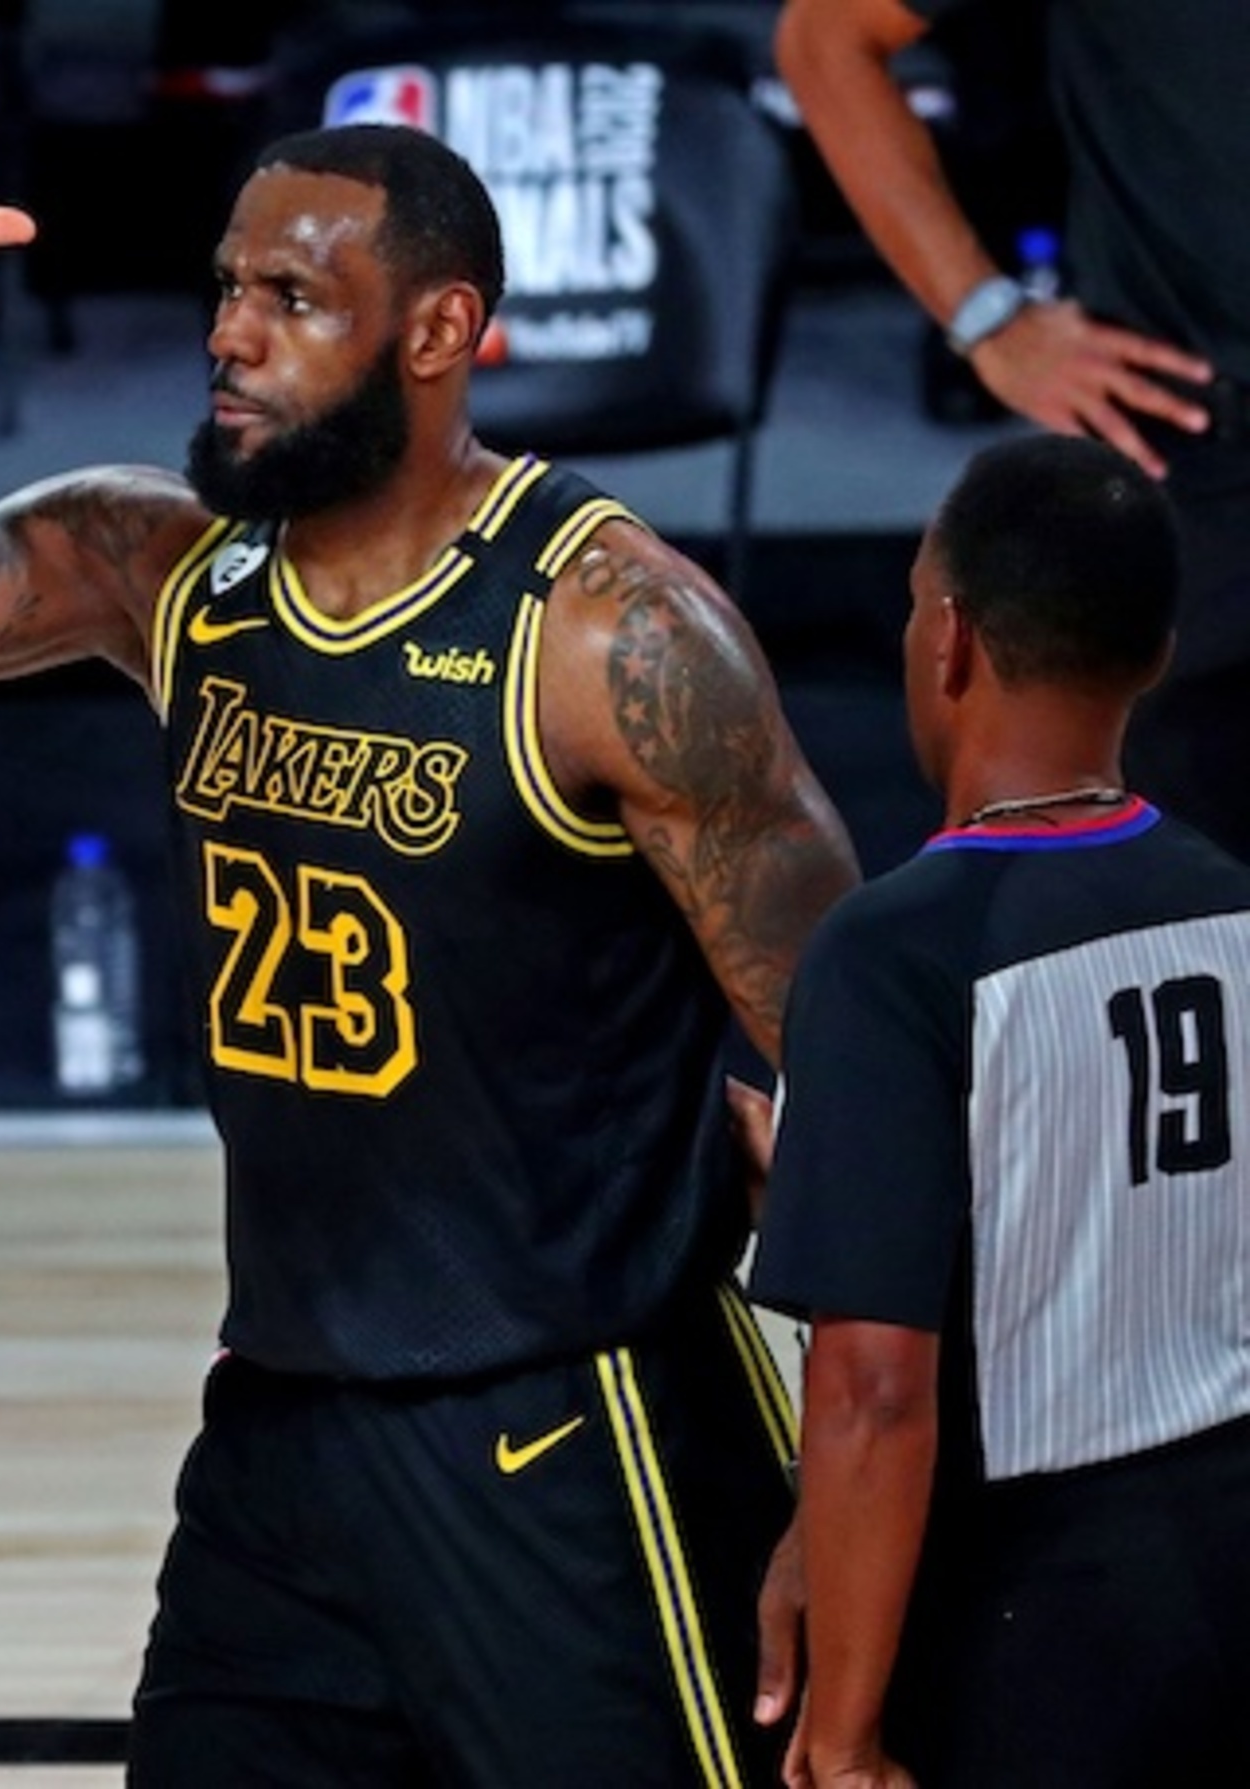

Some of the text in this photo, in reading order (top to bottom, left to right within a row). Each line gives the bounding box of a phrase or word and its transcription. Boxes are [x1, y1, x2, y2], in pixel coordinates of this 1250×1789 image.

[488, 172, 657, 296] NALS
[403, 640, 496, 685] wish
[175, 675, 470, 856] LAKERS
[203, 839, 418, 1098] 23
[1106, 973, 1232, 1188] 19
